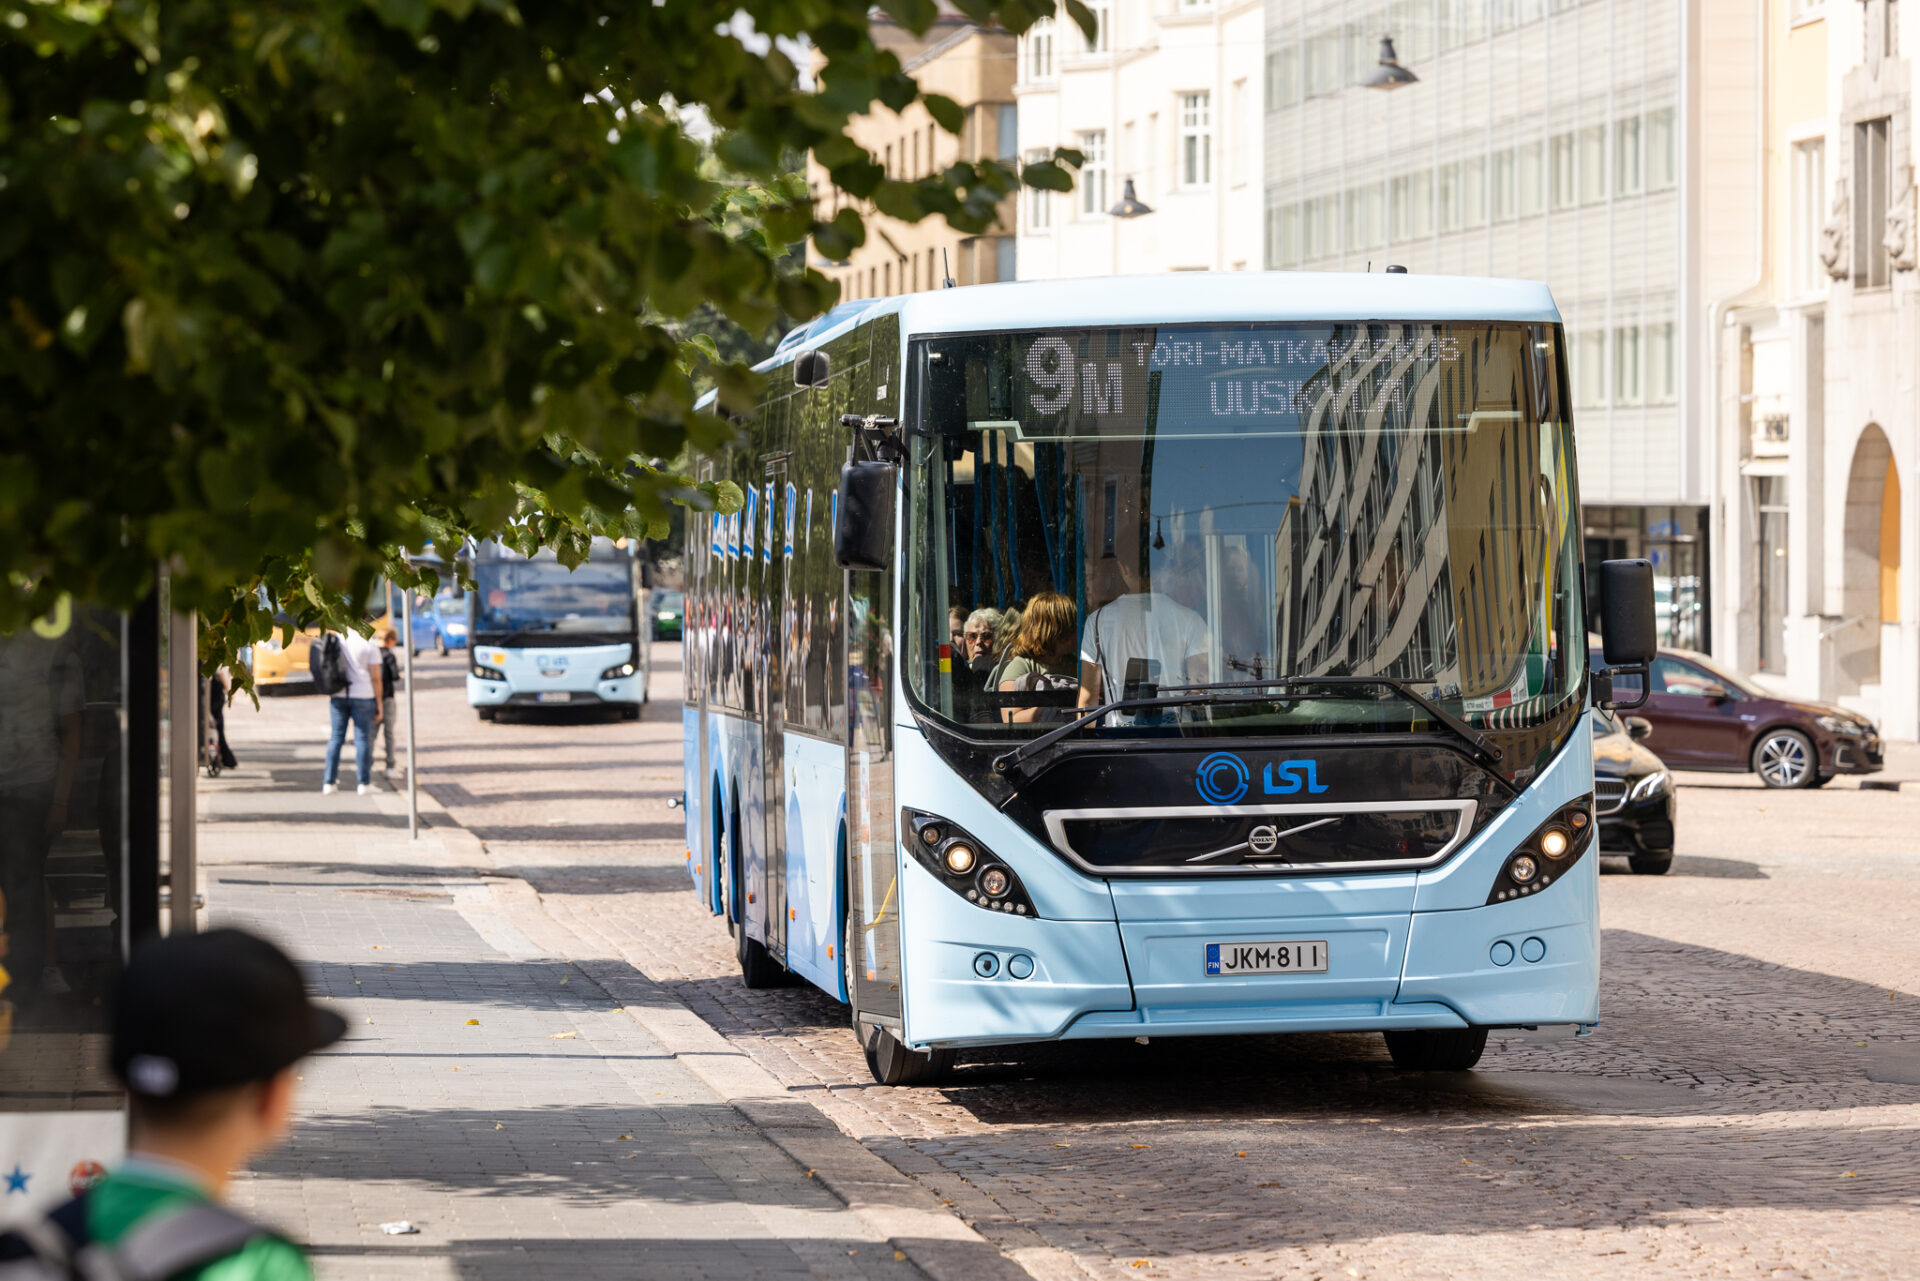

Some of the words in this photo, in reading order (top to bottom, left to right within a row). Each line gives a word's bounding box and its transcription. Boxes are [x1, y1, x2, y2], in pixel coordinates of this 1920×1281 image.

[1132, 337, 1460, 366] TORI-MATKAKESKUS
[1263, 760, 1329, 795] LSL
[1208, 961, 1220, 969] FIN
[1225, 945, 1318, 970] JKM-811
